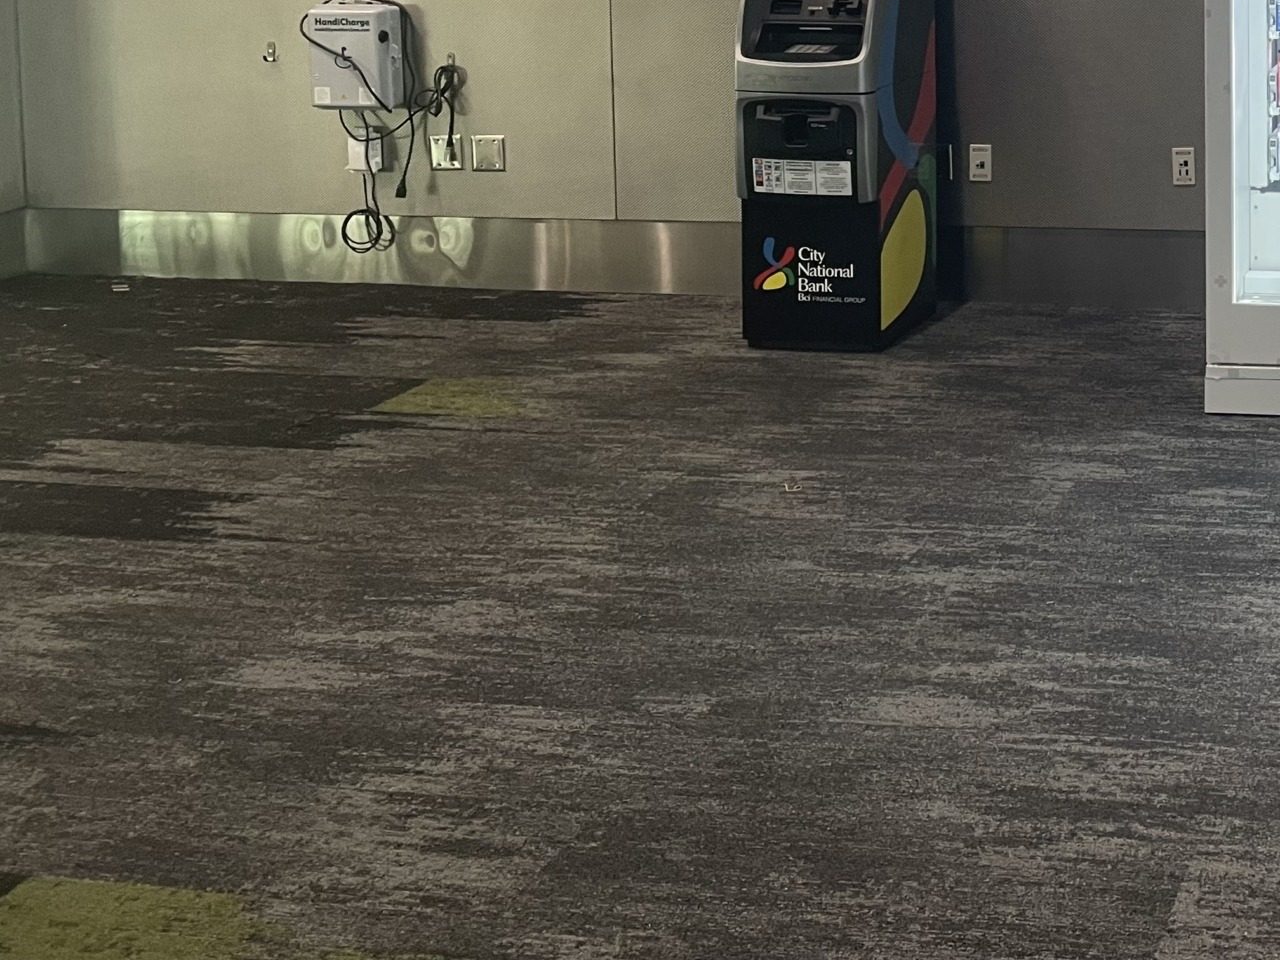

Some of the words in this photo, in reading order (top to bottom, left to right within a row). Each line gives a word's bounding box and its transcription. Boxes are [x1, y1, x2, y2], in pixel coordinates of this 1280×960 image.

[314, 17, 370, 27] HandiCharge
[798, 246, 825, 264] City
[797, 262, 854, 278] National
[798, 278, 833, 293] Bank
[798, 293, 810, 302] Bci
